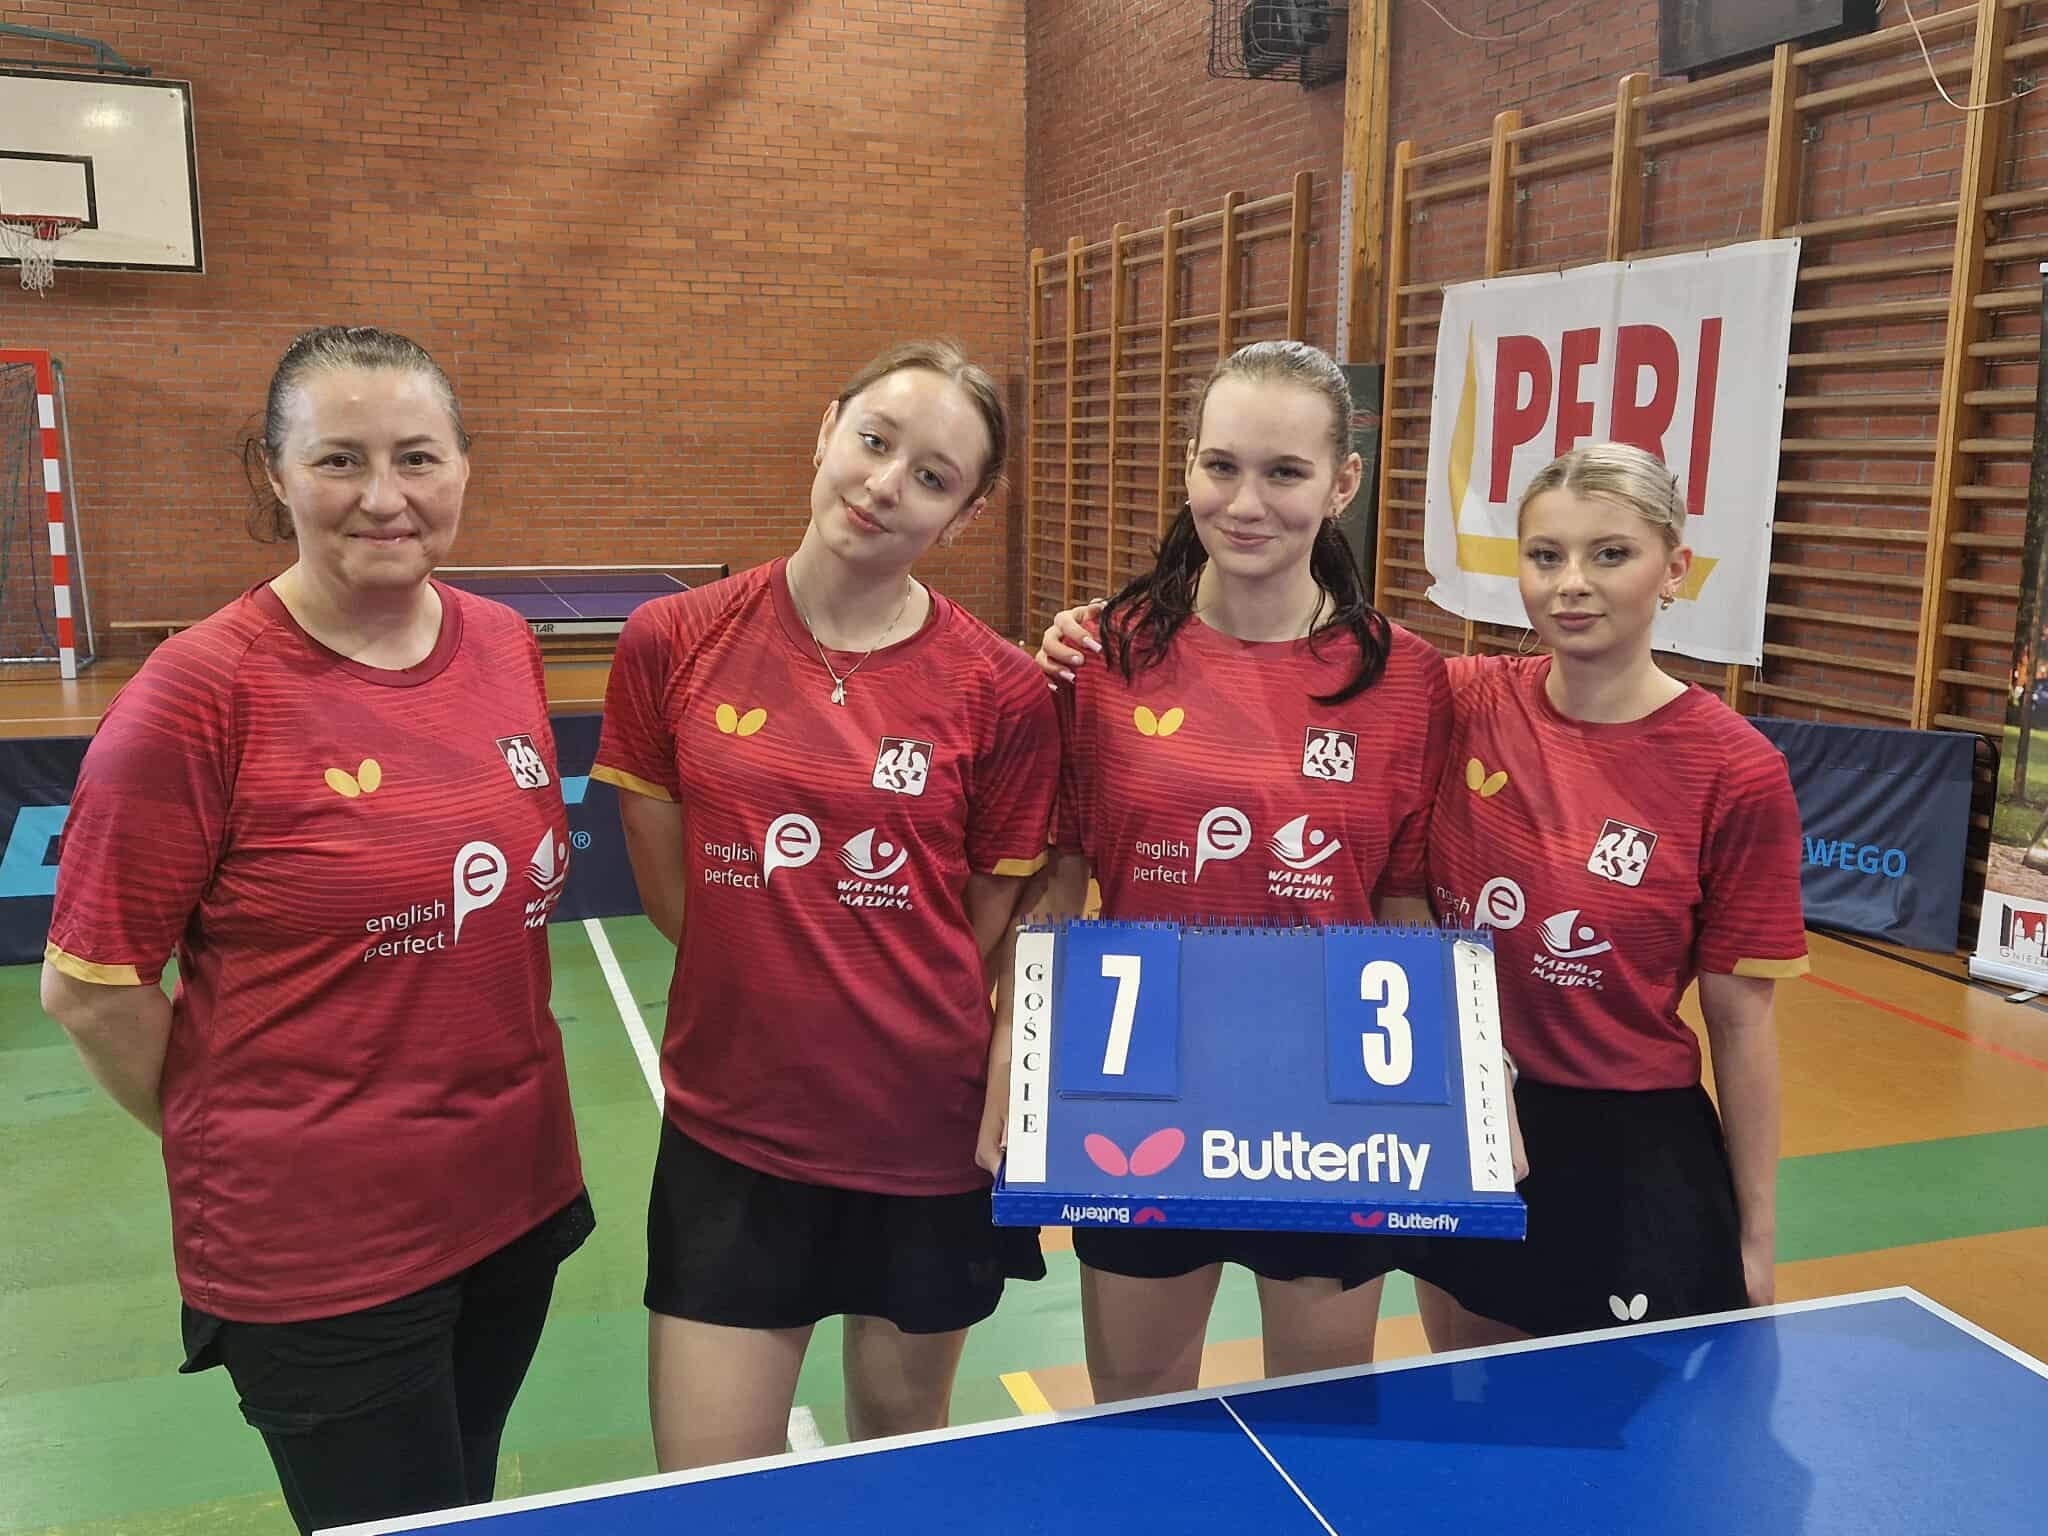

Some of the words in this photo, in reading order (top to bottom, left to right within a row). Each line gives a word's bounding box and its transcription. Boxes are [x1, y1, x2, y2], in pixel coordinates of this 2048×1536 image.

[1488, 316, 1723, 516] PERI
[704, 841, 759, 865] english
[1135, 839, 1190, 860] english
[704, 867, 760, 889] perfect
[1133, 865, 1188, 886] perfect
[1268, 870, 1334, 887] WARMIA
[837, 879, 909, 897] WARMIA
[1268, 884, 1332, 901] MAZURY
[838, 893, 908, 911] MAZURY
[366, 898, 446, 933] english
[364, 931, 446, 963] perfect
[1532, 953, 1603, 978] WARMIA
[1530, 966, 1600, 990] MAZURY
[1469, 949, 1487, 1042] STELLA
[1101, 954, 1142, 1076] 7
[1360, 960, 1415, 1087] 3
[1023, 963, 1044, 1134] GOŚCIE
[1202, 1129, 1431, 1191] Butterfly
[1061, 1204, 1130, 1224] Butterfly
[1387, 1211, 1460, 1233] Butterfly
